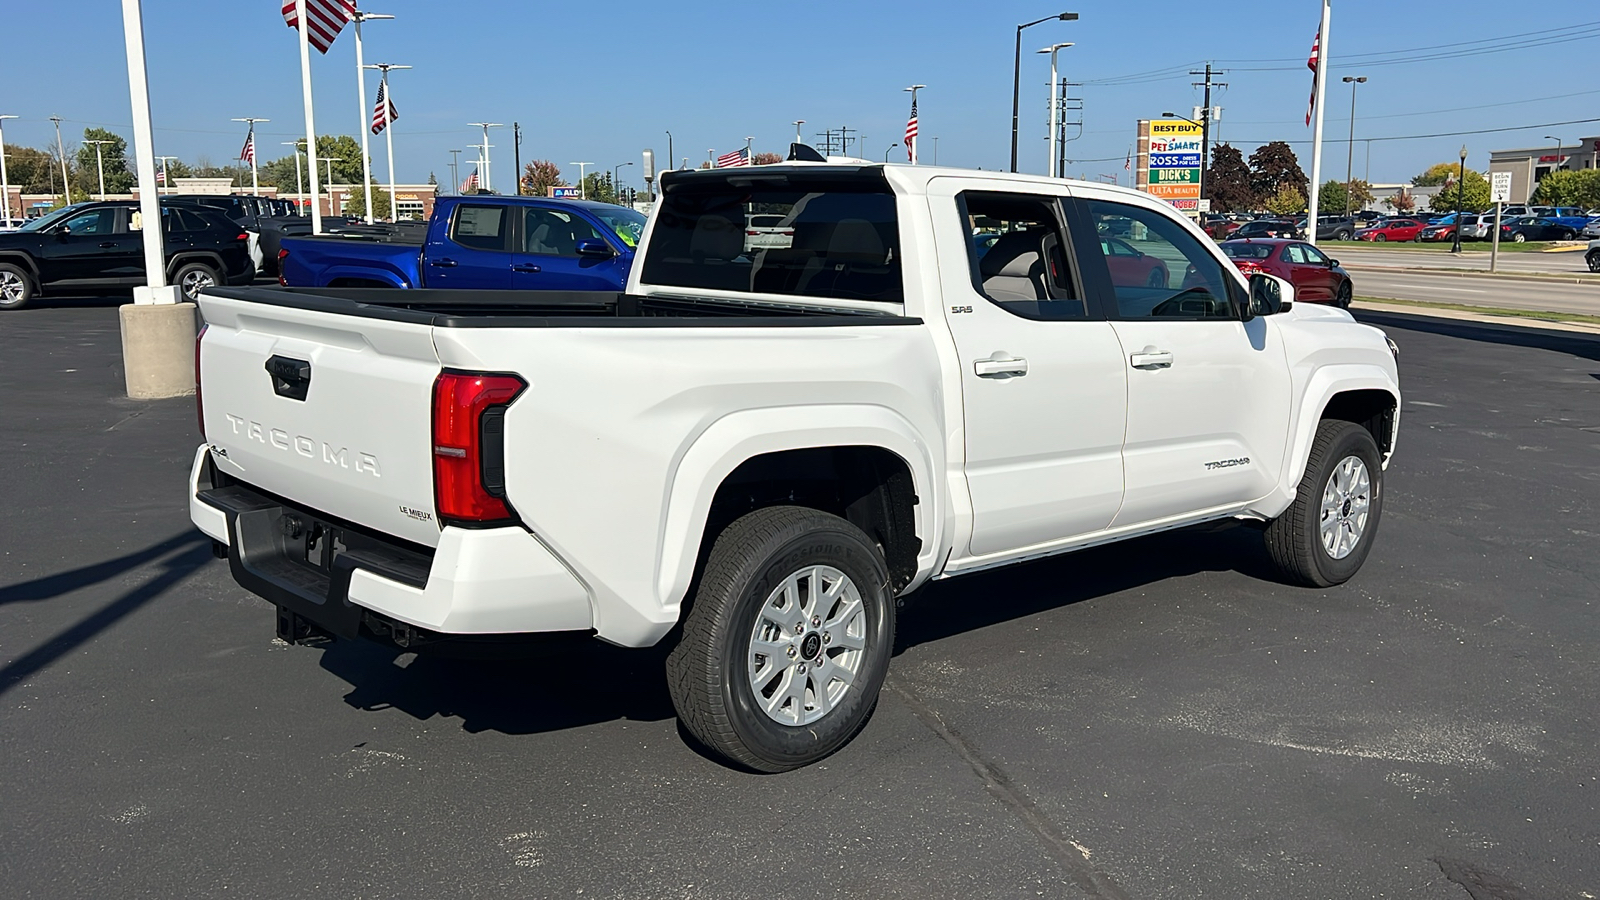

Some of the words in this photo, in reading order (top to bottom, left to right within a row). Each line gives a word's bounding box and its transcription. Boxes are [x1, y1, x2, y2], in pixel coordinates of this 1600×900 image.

[1151, 141, 1200, 152] PETSMART
[1150, 156, 1179, 166] ROSS
[1158, 169, 1191, 180] DICK'S
[1152, 186, 1172, 194] ULTA
[1174, 200, 1197, 208] LOBBY
[226, 412, 382, 478] TACOMA
[1204, 457, 1251, 471] TACOMA
[398, 505, 408, 514] LE
[408, 507, 432, 521] MIEUX
